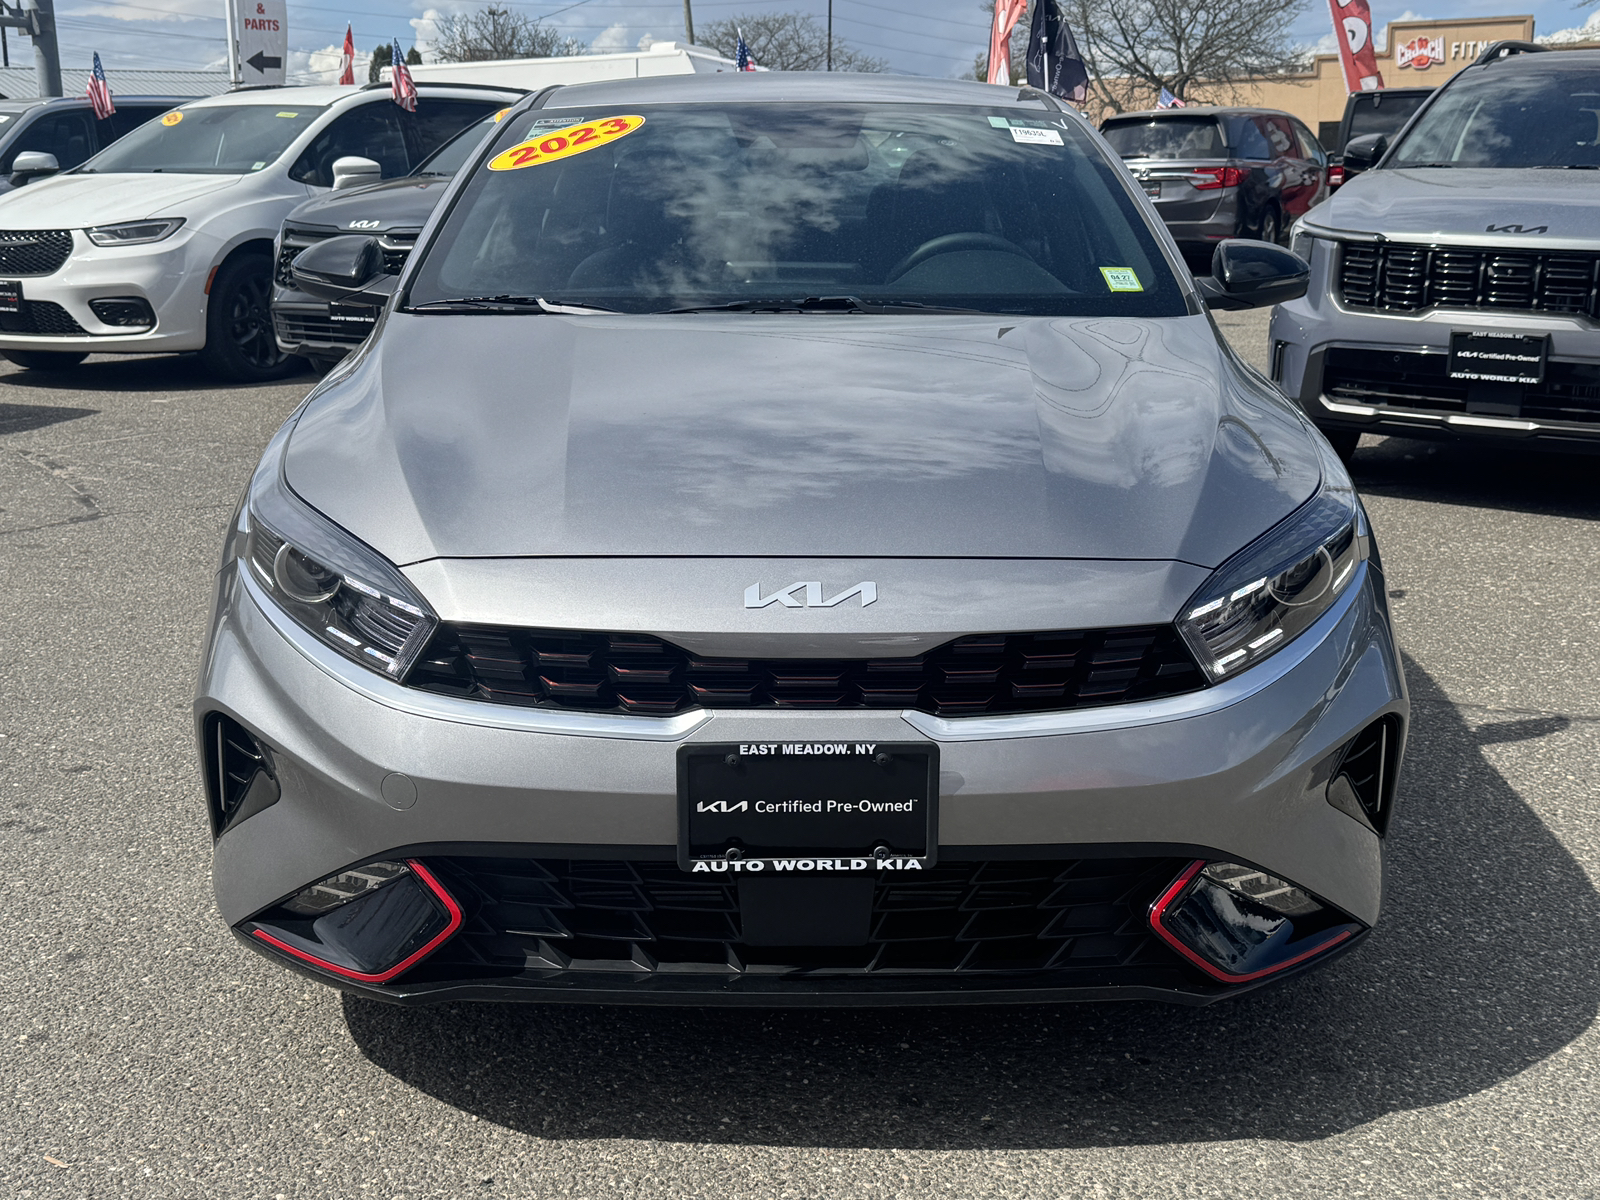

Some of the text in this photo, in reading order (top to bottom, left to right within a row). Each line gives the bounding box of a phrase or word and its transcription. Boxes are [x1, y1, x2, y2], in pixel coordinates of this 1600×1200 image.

[256, 3, 265, 14] &
[244, 18, 279, 31] PARTS
[1398, 36, 1444, 67] CRUNCH
[509, 119, 631, 166] 2023
[349, 220, 380, 228] KIA
[1486, 224, 1548, 234] KIA
[1479, 352, 1504, 360] Certified
[1450, 372, 1479, 380] AUTO
[1480, 374, 1517, 382] WORLD
[744, 580, 877, 608] KIA
[739, 744, 777, 755] EAST
[855, 744, 876, 755] NY
[696, 800, 749, 813] KIA
[755, 799, 822, 813] Certified
[692, 858, 923, 873] AUTO WORLD KIA
